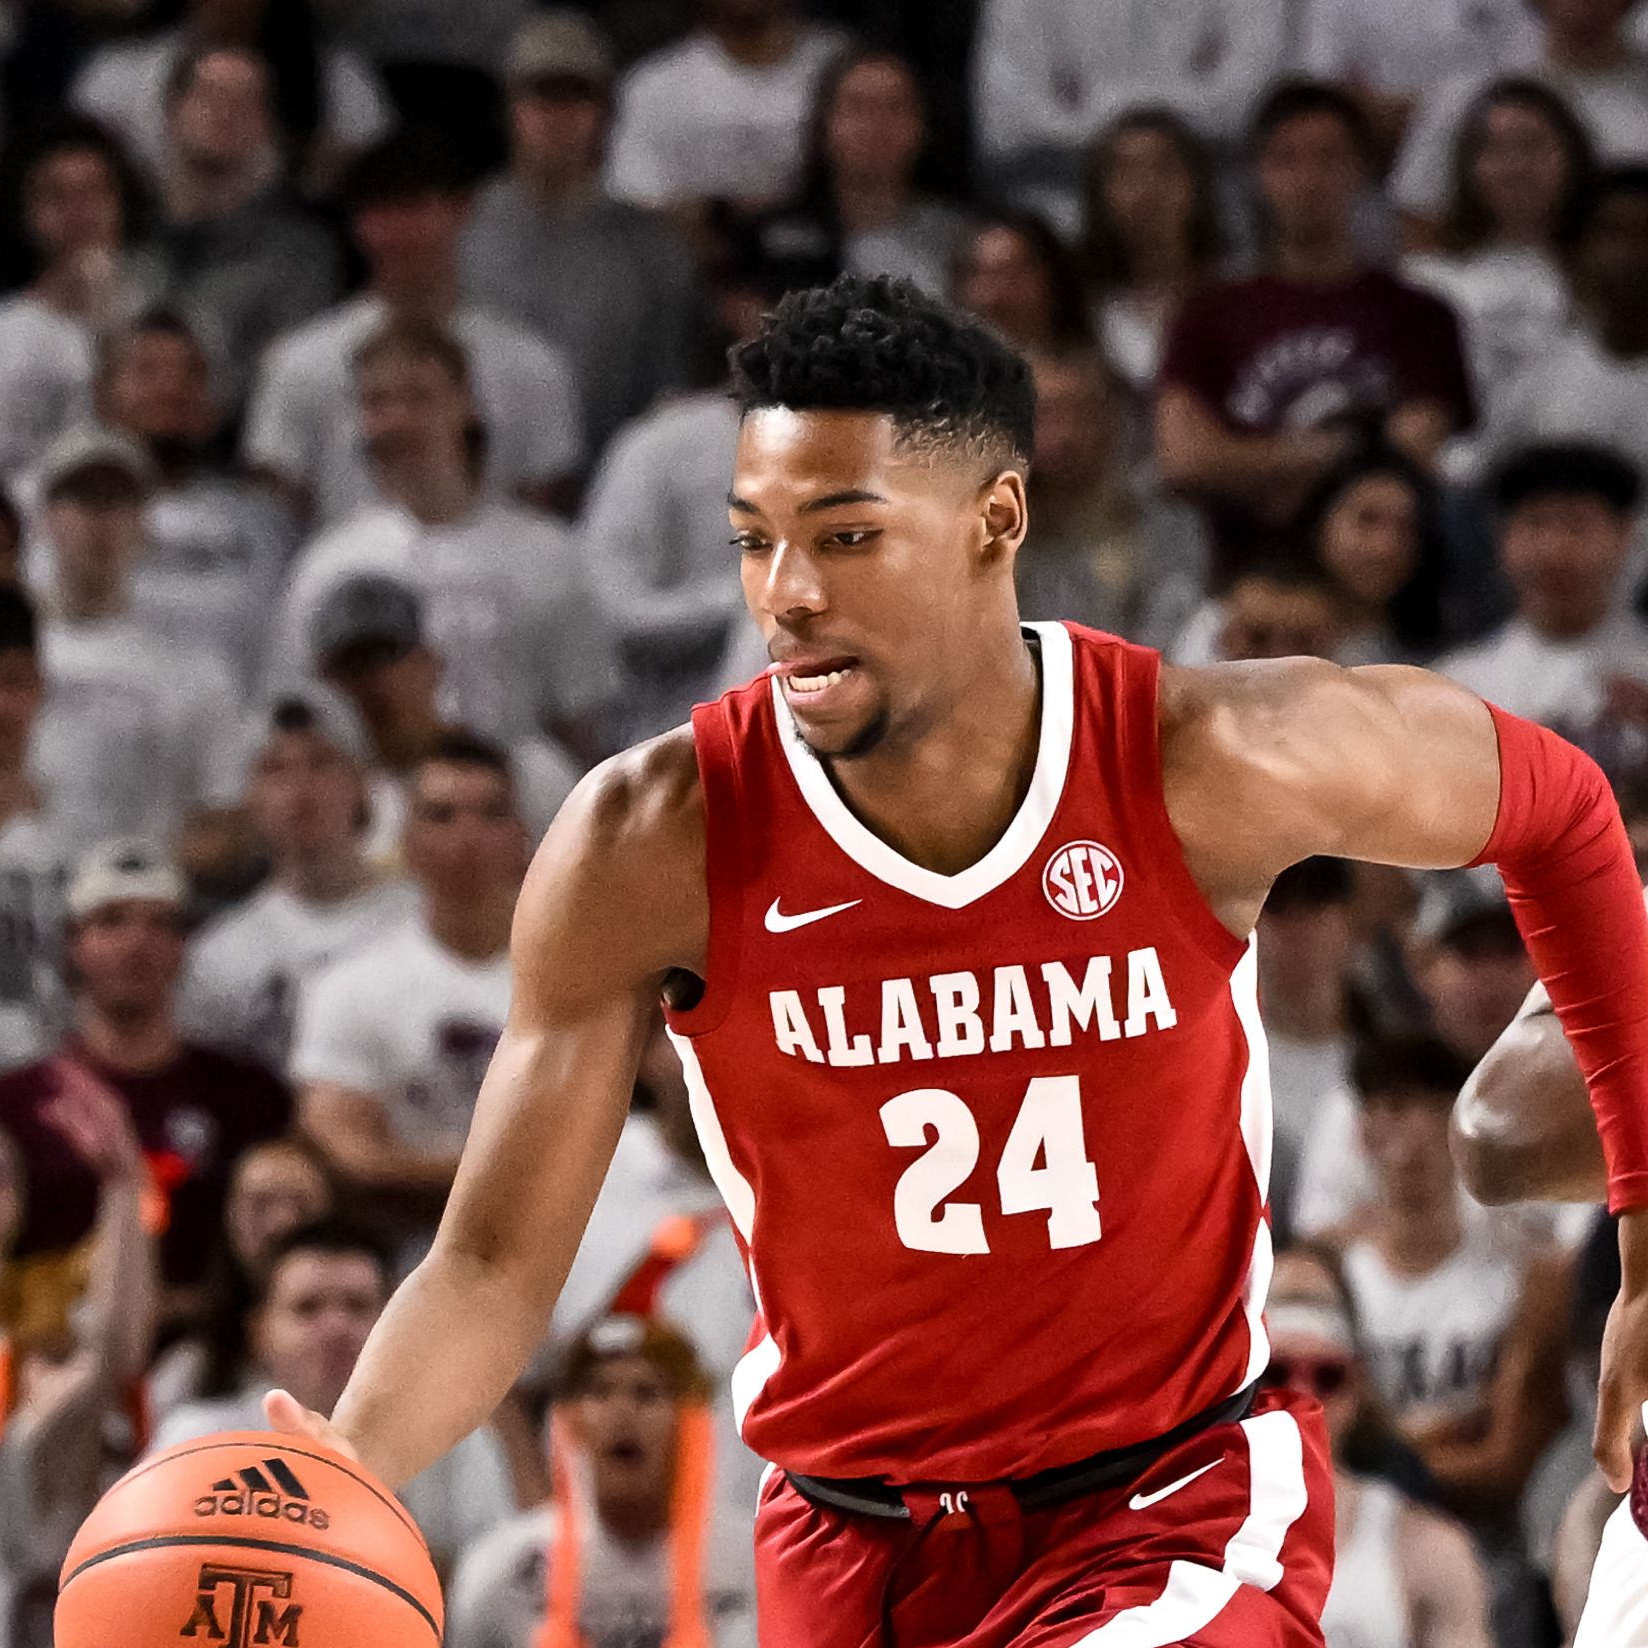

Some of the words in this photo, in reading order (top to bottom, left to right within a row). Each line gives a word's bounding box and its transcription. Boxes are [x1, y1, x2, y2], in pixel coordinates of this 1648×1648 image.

[1049, 846, 1119, 915] SEC
[769, 946, 1178, 1067] ALABAMA
[878, 1074, 1103, 1255] 24
[194, 1491, 330, 1530] adidas
